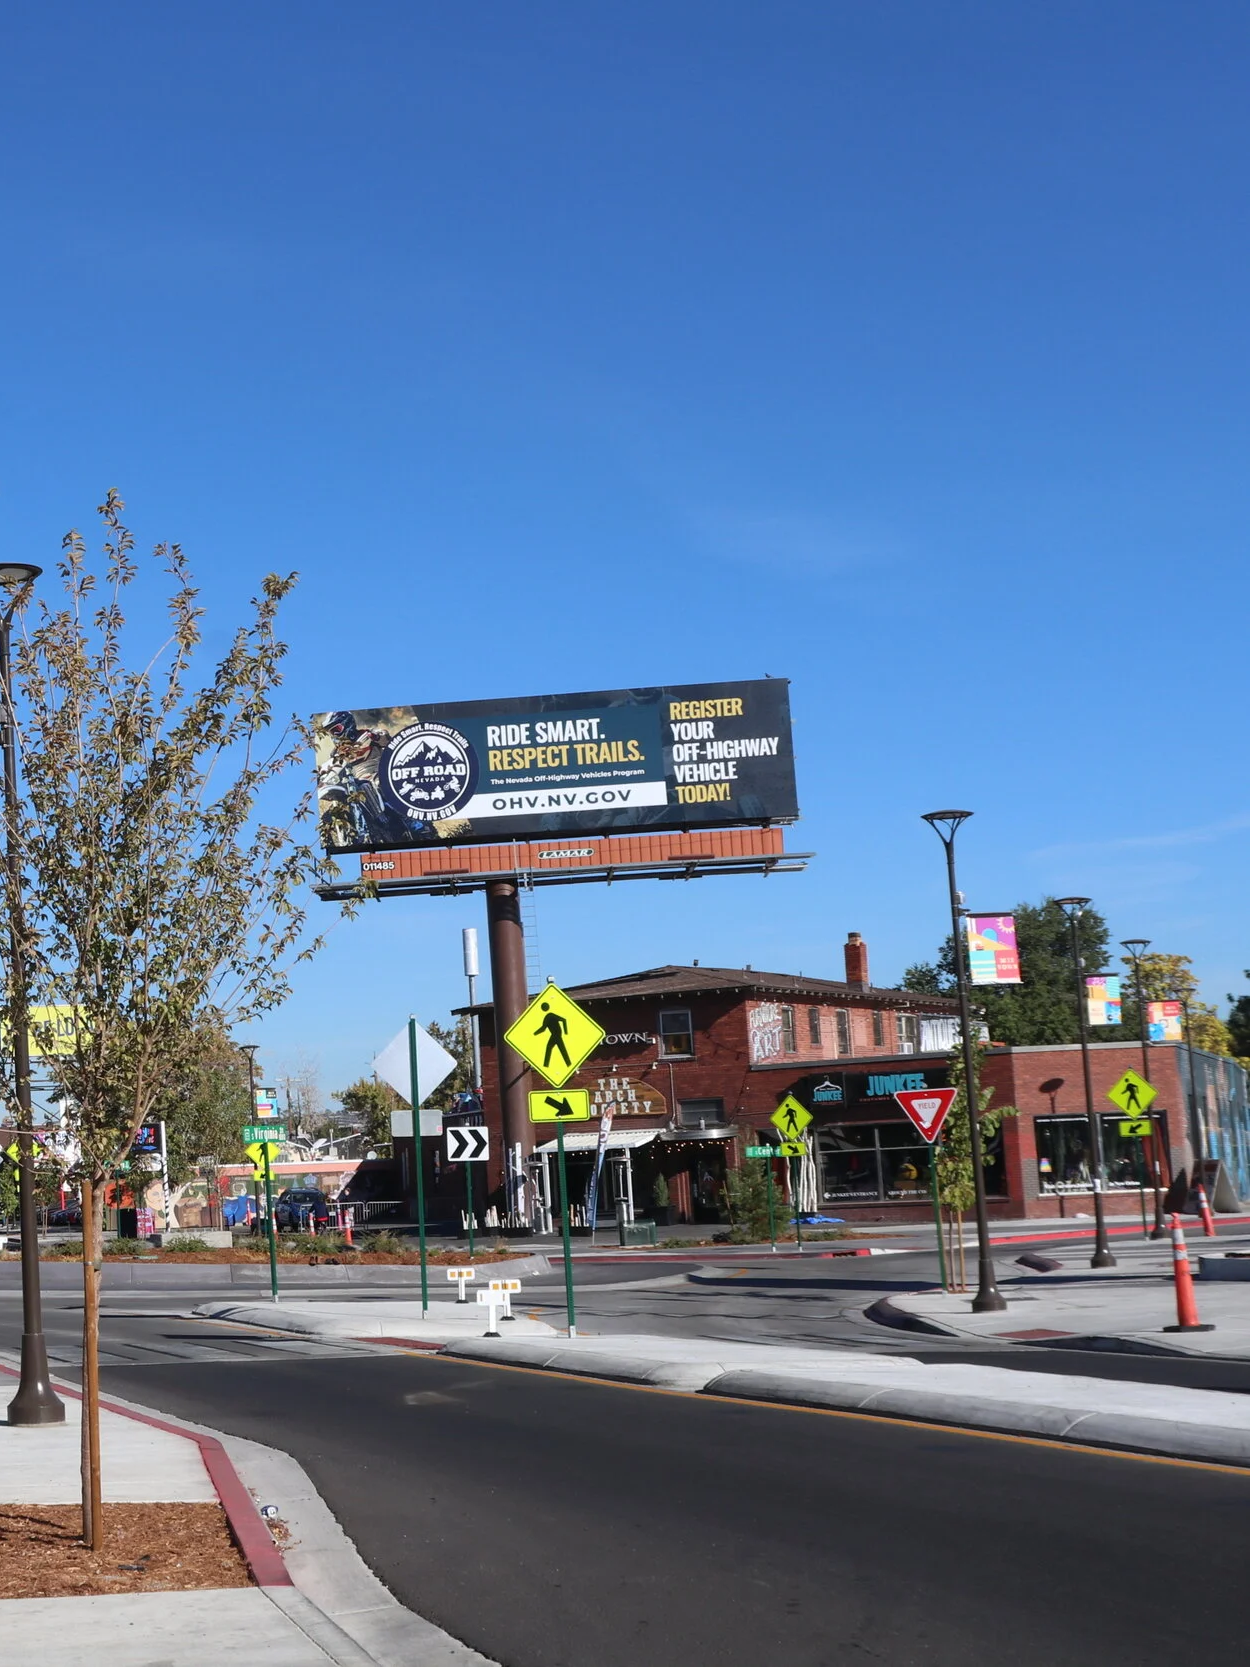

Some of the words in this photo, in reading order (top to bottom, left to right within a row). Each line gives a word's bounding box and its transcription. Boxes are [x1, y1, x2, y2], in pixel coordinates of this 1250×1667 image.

[670, 697, 743, 720] REGISTER
[388, 735, 402, 750] Ride
[424, 723, 453, 736] Respect
[452, 731, 469, 749] Trails
[487, 723, 531, 747] RIDE
[535, 718, 605, 743] SMART.
[670, 721, 715, 741] YOUR
[488, 745, 569, 771] RESPECT
[574, 740, 645, 765] TRAILS.
[672, 737, 779, 762] OFF-HIGHWAY
[391, 766, 420, 781] OFF
[423, 763, 466, 776] ROAD
[506, 776, 533, 784] Nevada
[534, 774, 580, 783] Off-Highway
[581, 771, 612, 779] Vehicles
[613, 768, 645, 778] Program
[673, 761, 738, 783] VEHICLE
[492, 790, 631, 810] OHV.NV.GOV
[675, 783, 731, 804] TODAY!
[407, 804, 457, 820] OHV.NV.GOV
[541, 849, 590, 858] LAMAR
[362, 862, 395, 871] 011485
[598, 1077, 630, 1090] THE
[866, 1073, 925, 1096] JUNKEE
[594, 1089, 636, 1103] ARCH
[813, 1090, 843, 1102] JUNKEE
[254, 1127, 278, 1142] Virginia
